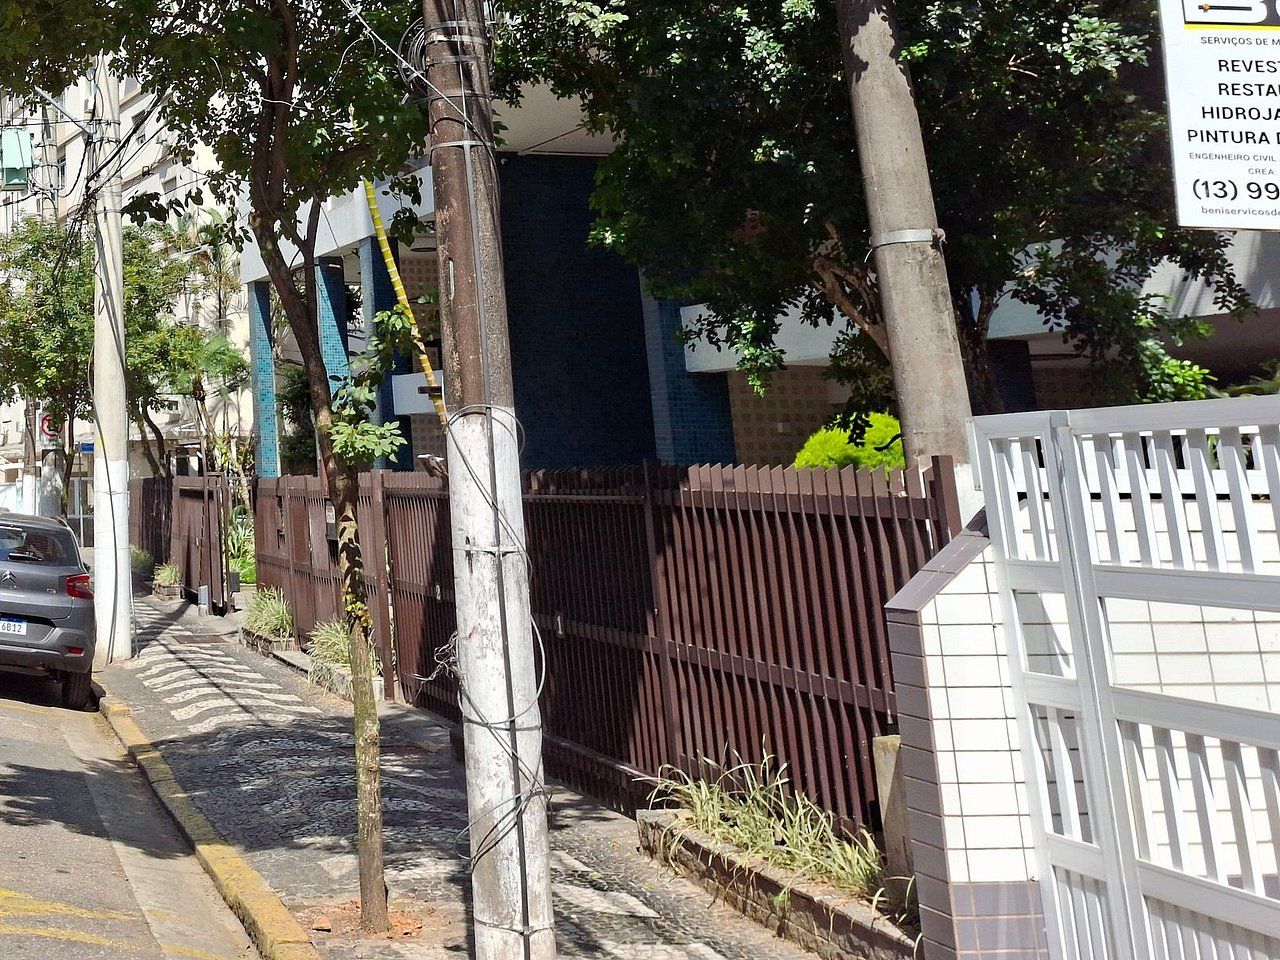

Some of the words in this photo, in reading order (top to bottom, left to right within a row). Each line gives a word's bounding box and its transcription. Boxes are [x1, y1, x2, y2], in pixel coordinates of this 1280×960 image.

[1200, 36, 1252, 46] SERVIÇOS
[1255, 38, 1268, 46] DE
[1218, 83, 1280, 96] RESTA
[1187, 129, 1270, 145] PINTURA
[1189, 152, 1251, 161] ENGENHEIRO
[1253, 154, 1277, 162] CIVIL
[1192, 178, 1238, 201] (13)
[1246, 181, 1280, 200] 99
